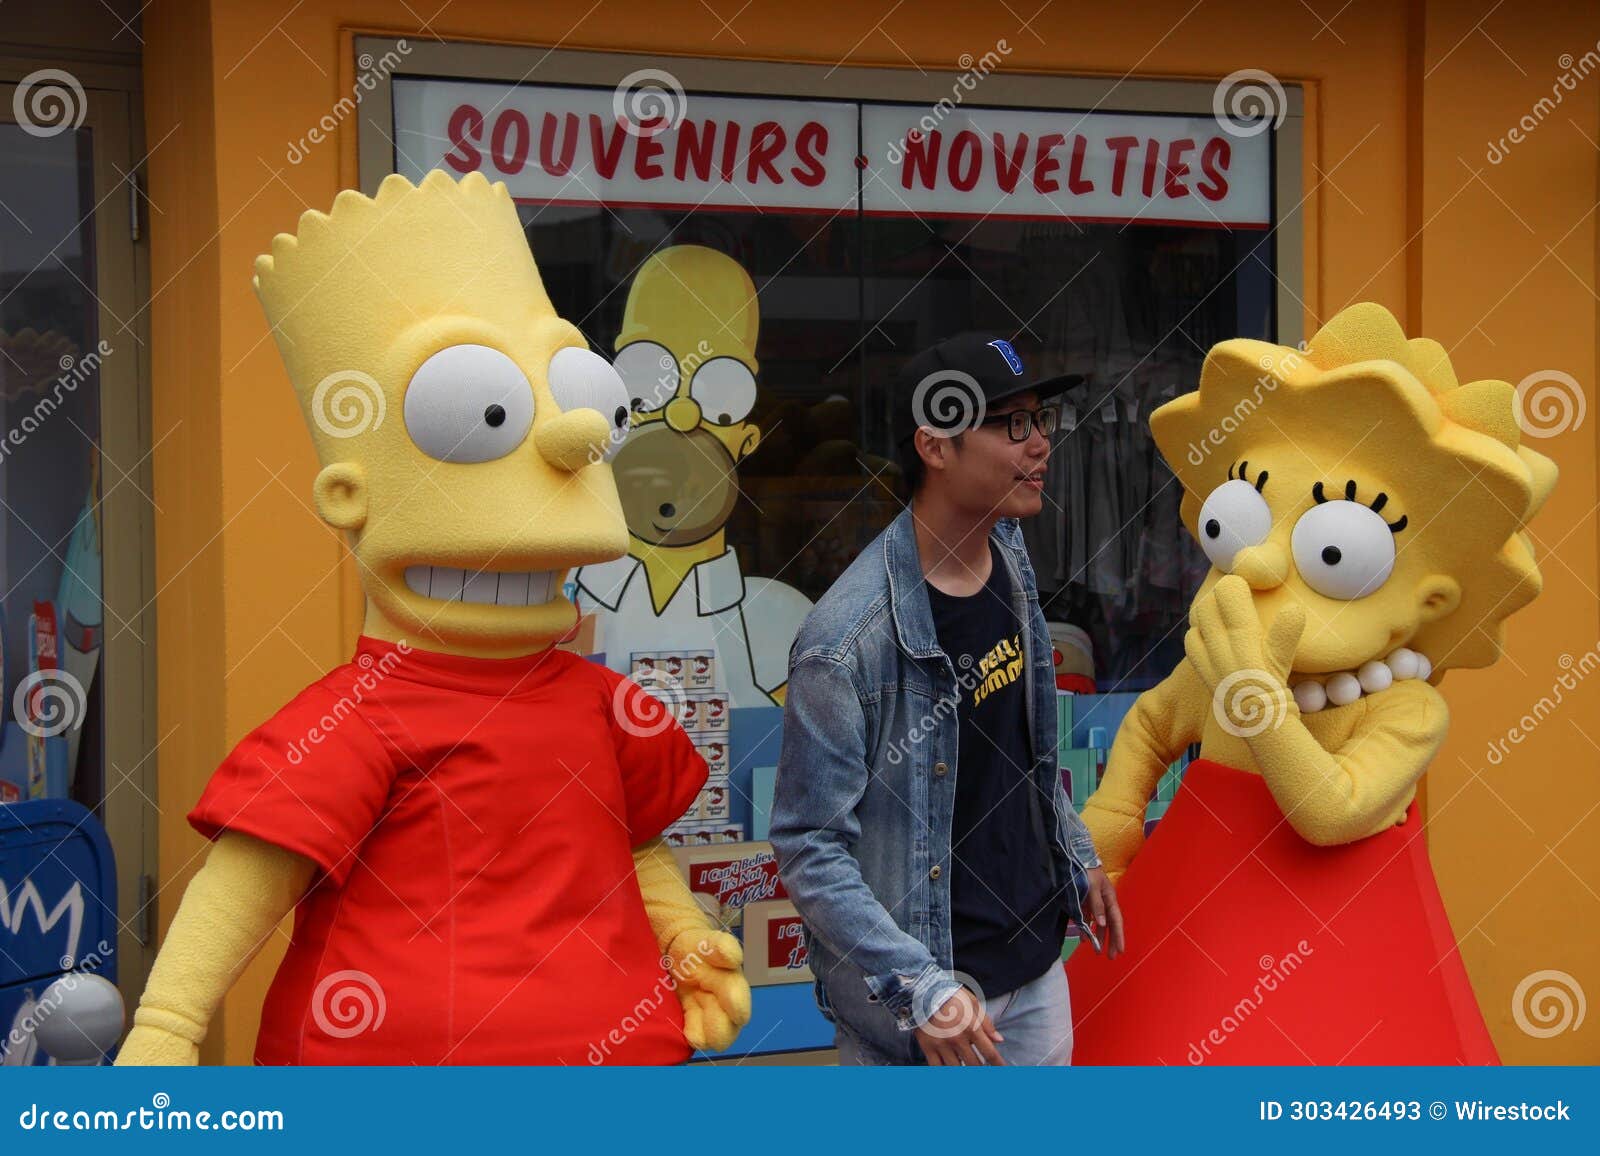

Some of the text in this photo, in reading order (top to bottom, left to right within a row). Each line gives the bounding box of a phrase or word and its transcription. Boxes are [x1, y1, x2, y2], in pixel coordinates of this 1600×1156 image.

[445, 104, 1232, 202] SOUVENIRS NOVELTIES
[708, 861, 740, 882] Can't
[740, 852, 776, 872] Believ
[720, 866, 763, 893] It's Not
[714, 872, 779, 909] ard!
